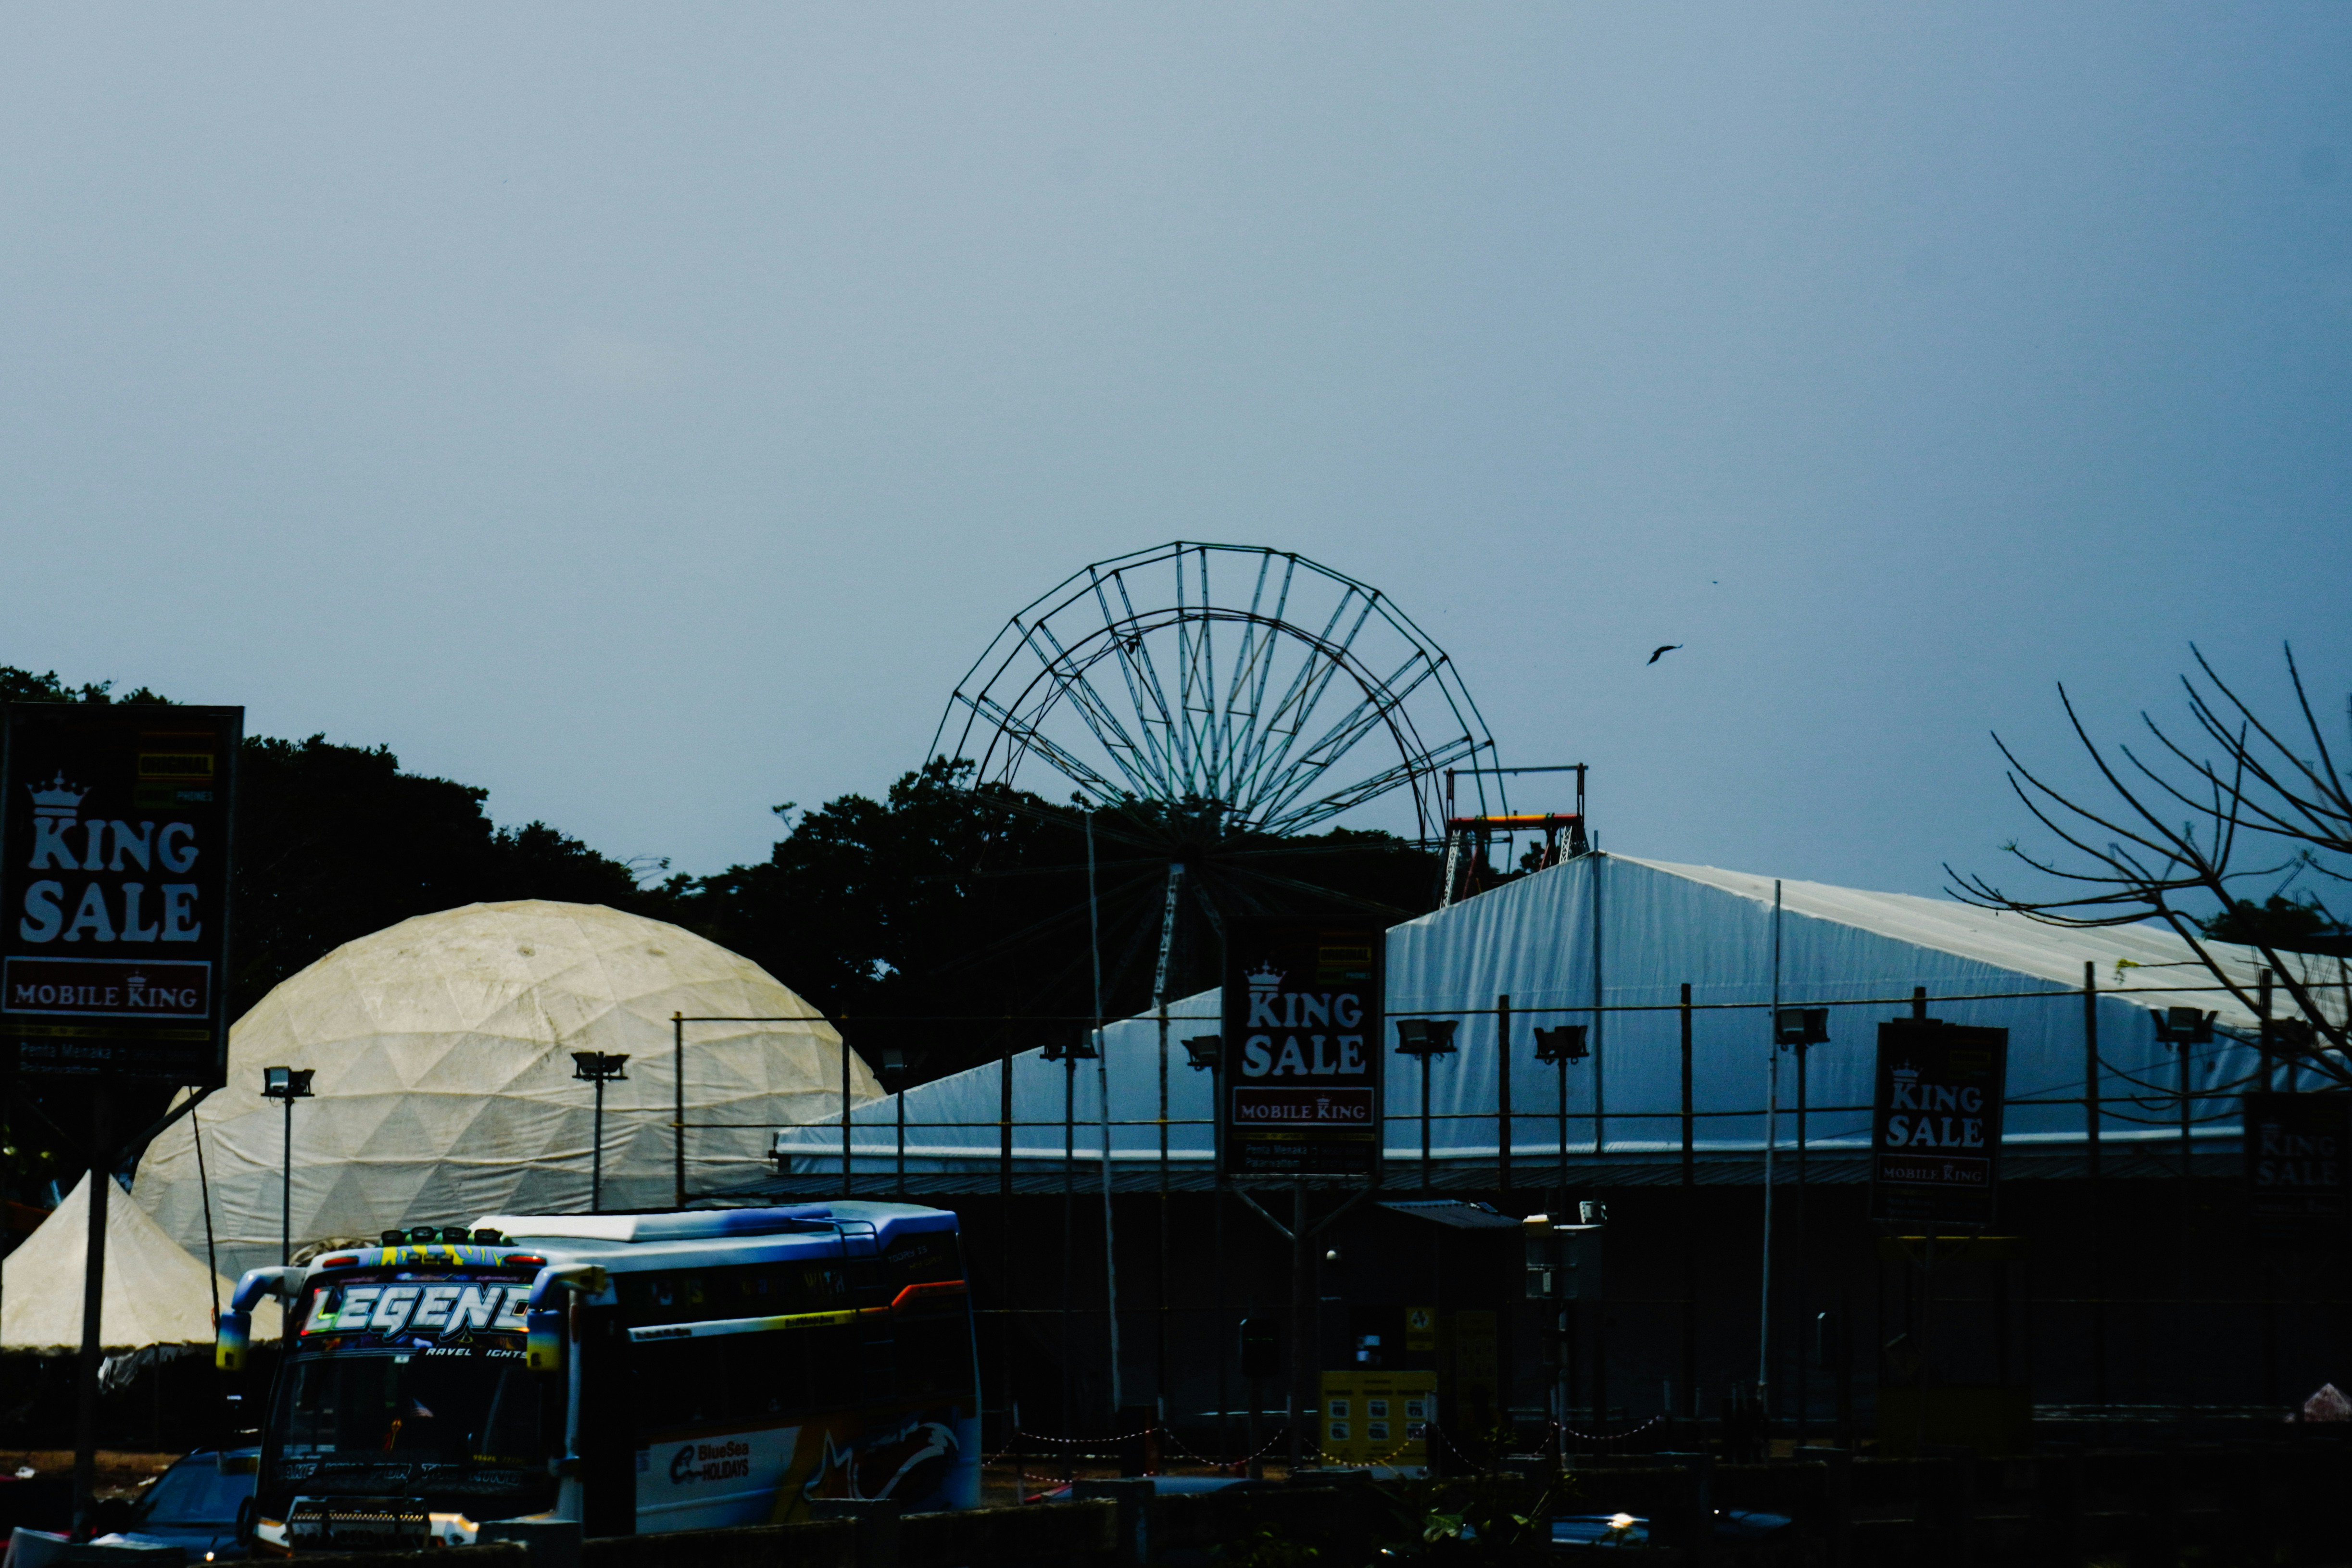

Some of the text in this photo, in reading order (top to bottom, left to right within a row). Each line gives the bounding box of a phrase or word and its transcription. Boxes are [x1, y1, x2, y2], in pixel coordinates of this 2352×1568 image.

[28, 817, 200, 874] KING
[20, 880, 202, 943] SALE
[14, 984, 197, 1008] MOBILE KING
[1246, 991, 1363, 1029] KING
[1242, 1034, 1366, 1077] SALE
[1891, 1082, 1984, 1113] KING
[1240, 1104, 1365, 1119] MOBILE KING
[1886, 1115, 1985, 1148] SALE
[2259, 1131, 2337, 1157] KING
[1883, 1167, 1982, 1182] MOBILE KING
[2255, 1160, 2340, 1186] SALE
[420, 1347, 528, 1359] RAVEL IGHTS
[703, 1458, 748, 1480] HOLIDAYS
